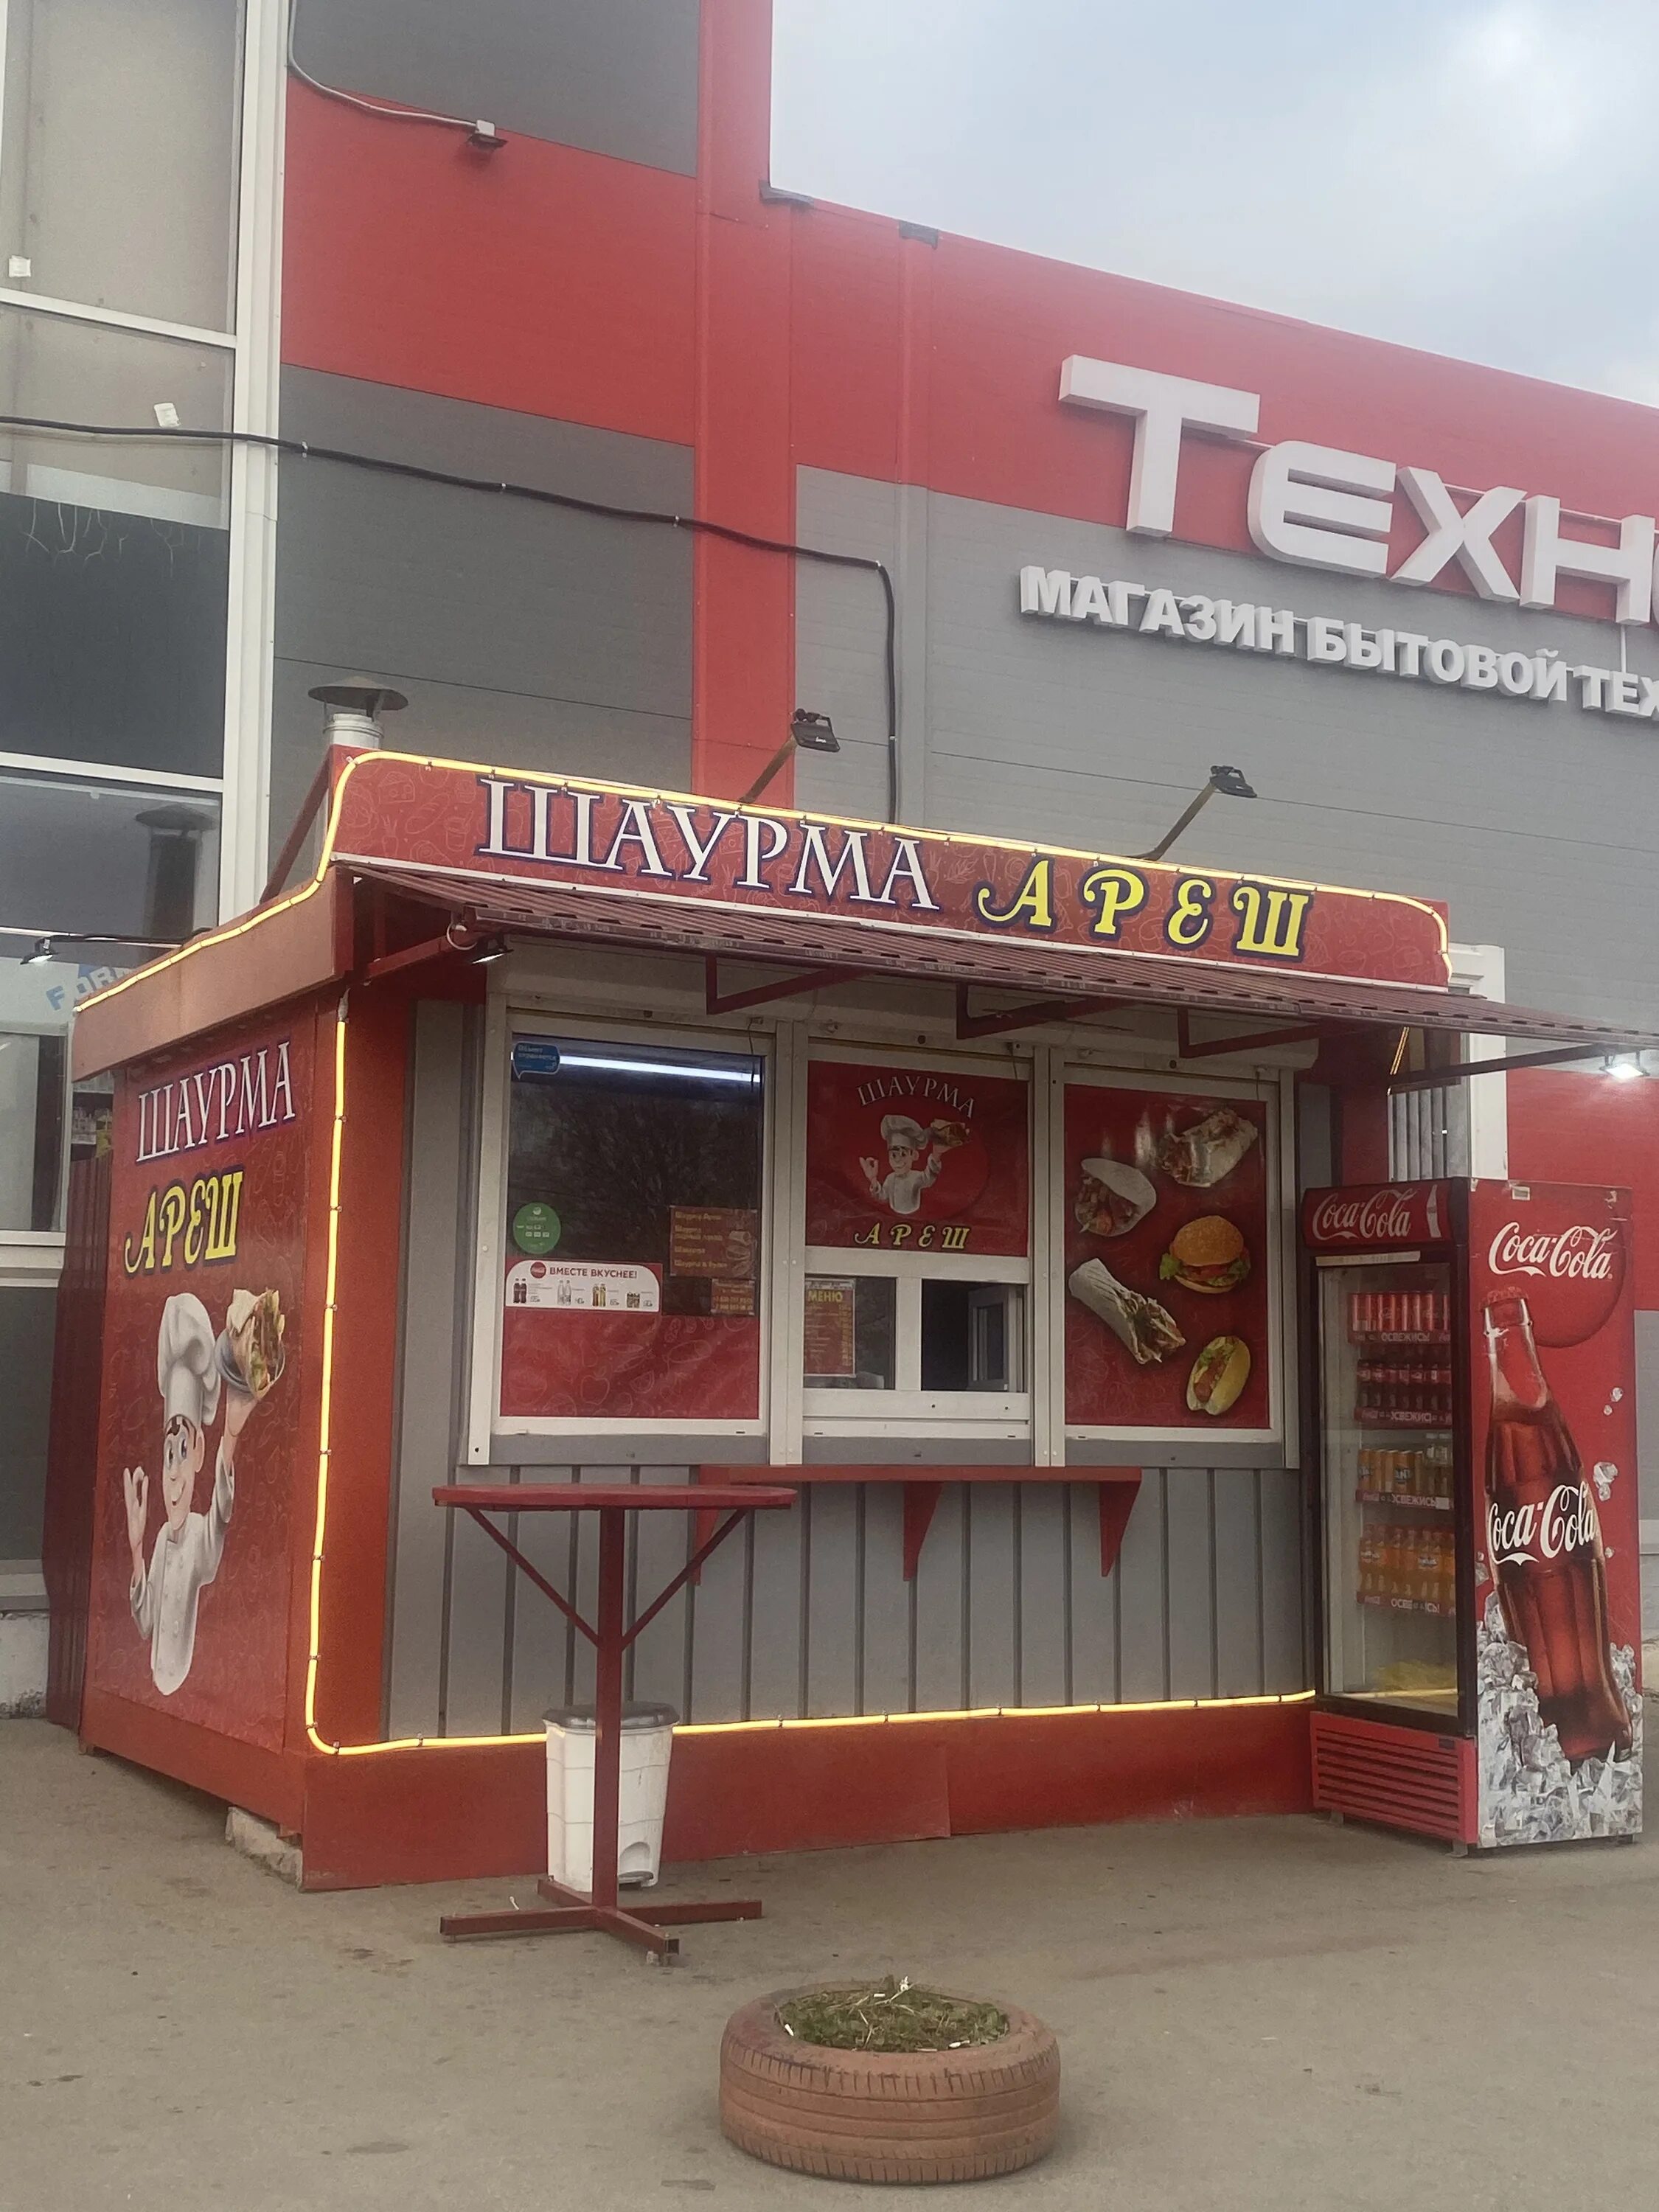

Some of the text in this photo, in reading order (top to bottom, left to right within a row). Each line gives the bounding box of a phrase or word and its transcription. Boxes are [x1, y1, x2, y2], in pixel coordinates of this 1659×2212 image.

[1058, 354, 1659, 625] ТЕХН
[1020, 566, 1295, 656] МАГАЗИН
[1306, 615, 1568, 701] БЫТОВОЙ
[477, 776, 1310, 958] ШАУРМА АРЕШ
[136, 1040, 296, 1163] ШАУРМА
[855, 1075, 975, 1119] ШАУРМА
[124, 1171, 243, 1273] АРЕШ
[854, 1222, 970, 1250] АРЕШ
[1312, 1189, 1412, 1240] Coca-Cola
[1488, 1221, 1617, 1279] Coca-Cola
[549, 1267, 637, 1279] ВМЕСТЕ ВКУСНЕЕ!
[807, 1289, 844, 1303] МЕНЮ
[1487, 1481, 1599, 1565] Coca-Cola
